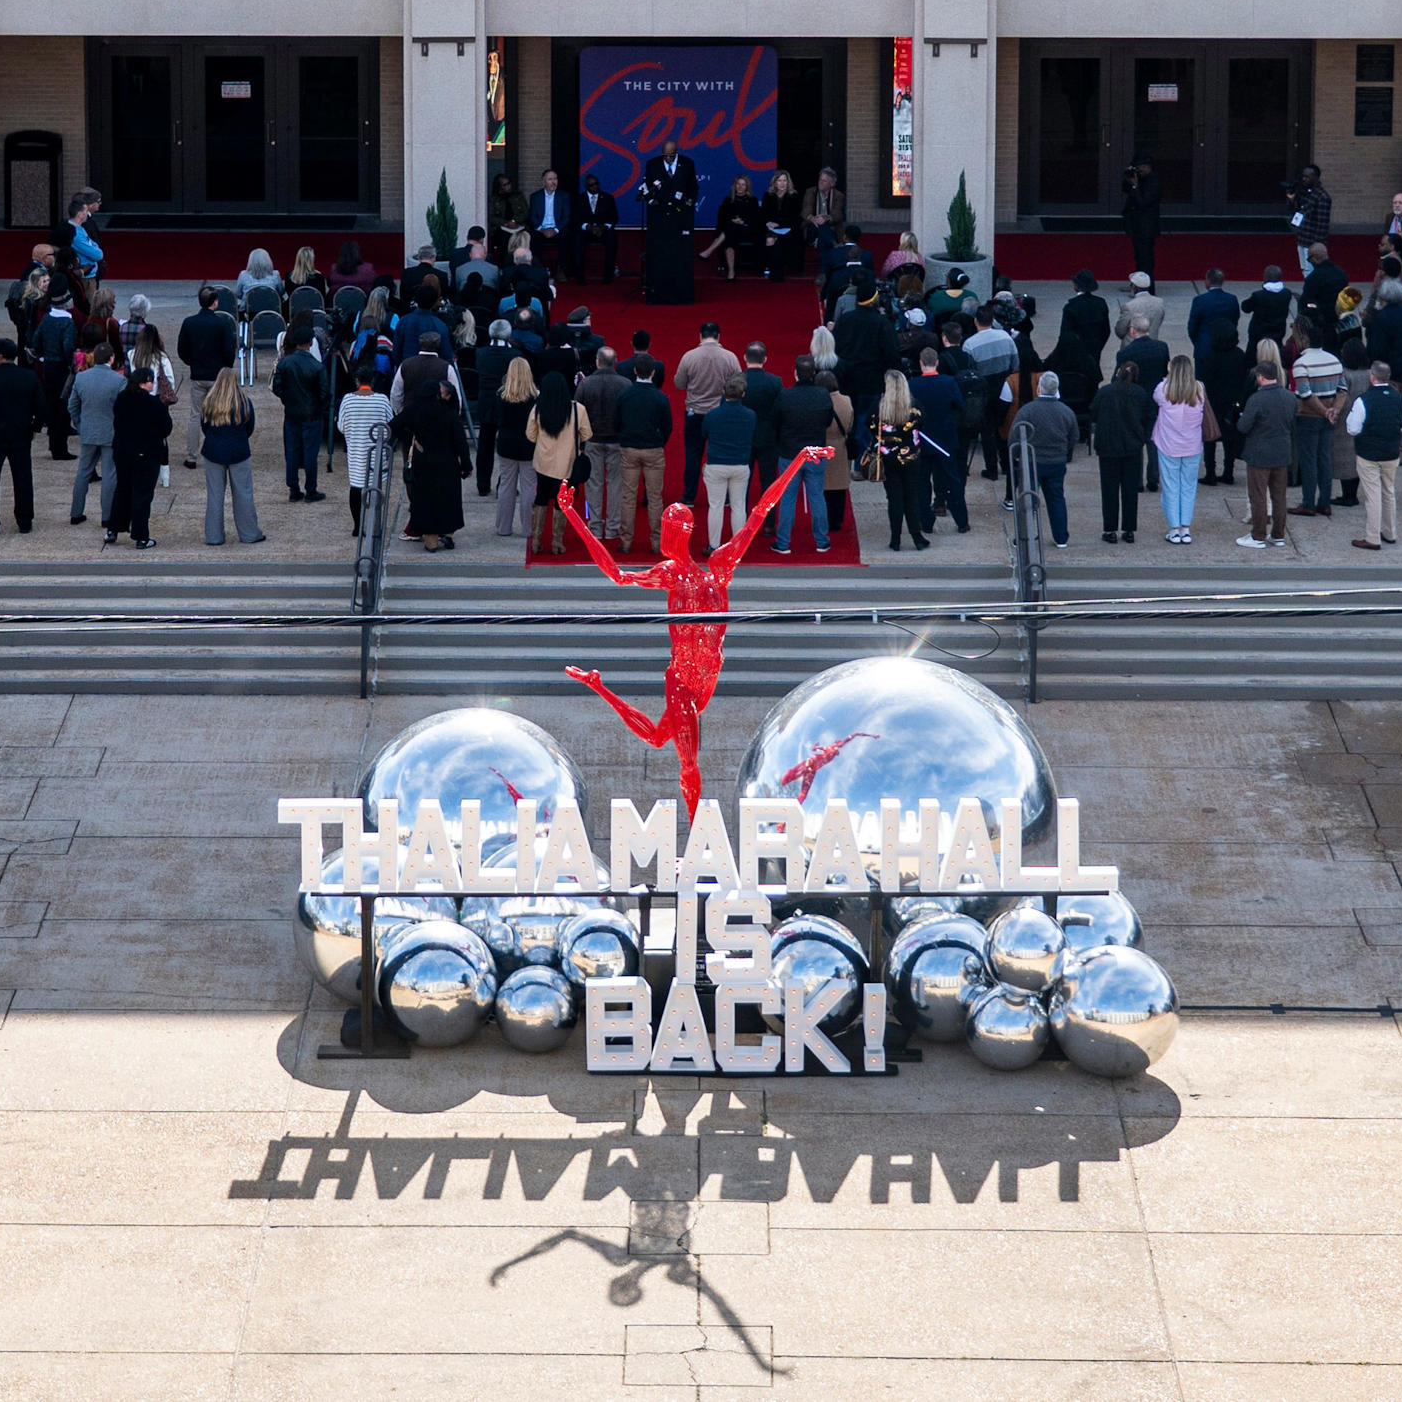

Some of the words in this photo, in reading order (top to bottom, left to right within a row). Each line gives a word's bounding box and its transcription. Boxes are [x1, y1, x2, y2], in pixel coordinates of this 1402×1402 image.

[579, 45, 778, 198] Soul
[624, 81, 652, 91] THE
[657, 81, 691, 91] CITY
[696, 81, 734, 91] WITH
[277, 798, 599, 893] THALIA
[610, 798, 871, 893] MARA
[880, 798, 1119, 893] HALL
[675, 886, 772, 985] IS
[585, 975, 887, 1073] BACK!
